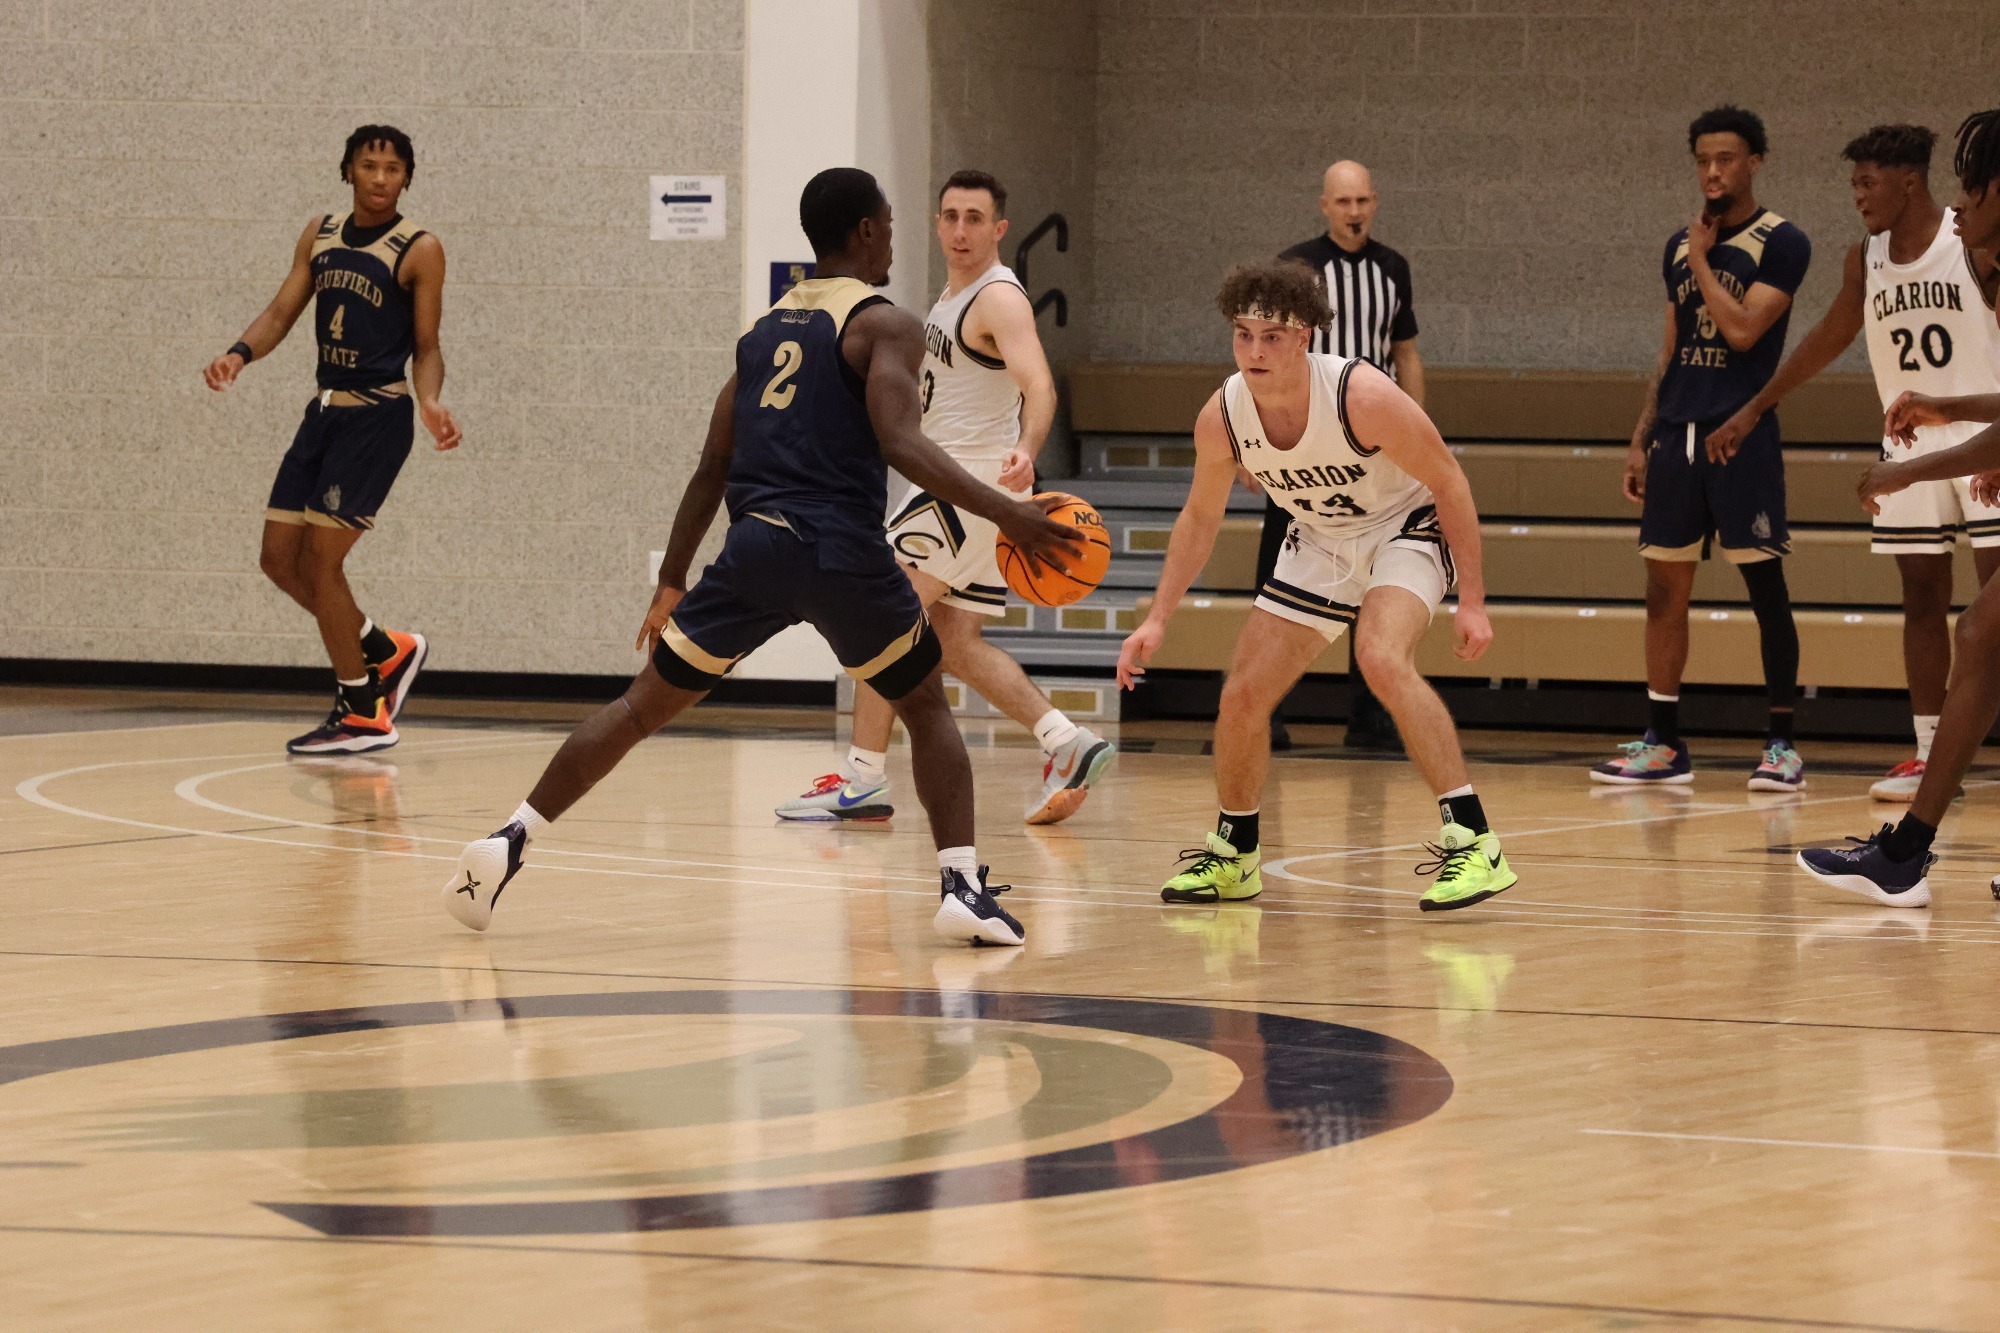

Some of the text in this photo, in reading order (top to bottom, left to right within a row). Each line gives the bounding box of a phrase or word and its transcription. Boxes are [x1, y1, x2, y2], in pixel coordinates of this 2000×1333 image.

[1873, 281, 1963, 321] CLARION
[329, 304, 345, 340] 4
[323, 344, 359, 368] TATE
[1680, 346, 1728, 368] SATE
[1890, 323, 1953, 371] 20
[759, 340, 803, 410] 2
[1255, 463, 1367, 491] CLARION
